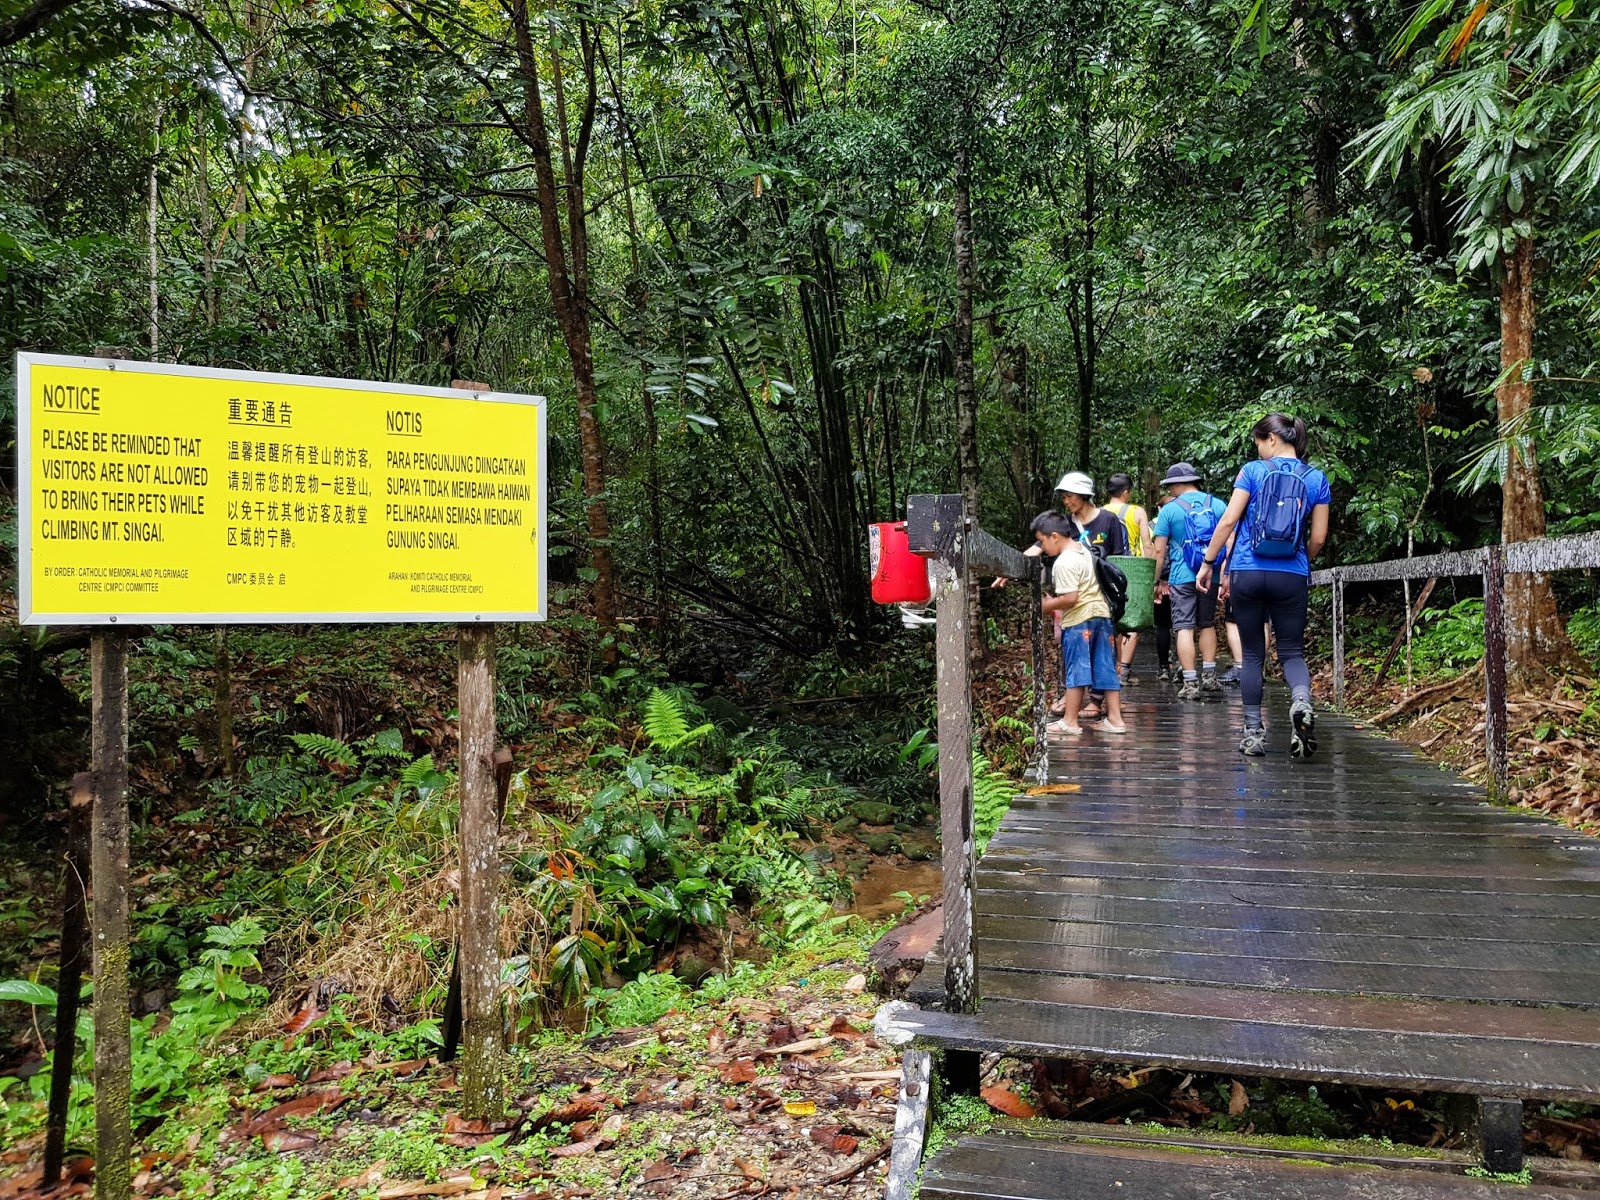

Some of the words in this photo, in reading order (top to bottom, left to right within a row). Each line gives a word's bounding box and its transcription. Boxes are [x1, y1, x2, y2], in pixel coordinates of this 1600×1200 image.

[44, 384, 100, 411] NOTICE
[228, 398, 292, 424] 重要通告
[387, 410, 422, 433] NOTIS
[43, 429, 89, 450] PLEASE
[92, 432, 107, 452] BE
[111, 434, 170, 455] REMINDED
[174, 438, 201, 457] THAT
[43, 459, 95, 481] VISITORS
[101, 463, 123, 482] ARE
[127, 464, 150, 483] NOT
[154, 466, 208, 486] ALLOWED
[387, 451, 411, 469] PARA
[414, 453, 473, 473] PENGUNJUNG
[476, 456, 525, 476] DIINGATKAN
[387, 477, 421, 496] SUPAYA
[424, 479, 449, 497] TIDAK
[452, 481, 495, 499] MEMBAWA
[498, 484, 530, 501] HAIWAN
[42, 489, 57, 509] TO
[62, 491, 97, 511] BRING
[102, 492, 135, 512] THEIR
[138, 494, 166, 514] PETS
[170, 495, 204, 514] WHILE
[228, 500, 367, 524] 以免干扰其他访客及教堂
[386, 504, 443, 523] PELIHARAAN
[446, 507, 482, 525] SEMASA
[484, 508, 521, 526] MENDAKI
[42, 519, 98, 540] CLIMBING
[102, 522, 120, 541] MT.
[124, 523, 165, 542] SINGAI.
[387, 530, 425, 549] GUNUNG
[428, 532, 459, 550] SINGAI.
[45, 567, 52, 576] BY
[79, 568, 107, 577] CATHOLIC
[109, 569, 139, 578] MEMORIAL
[141, 569, 152, 578] AND
[154, 569, 188, 578] PILGRIMAGE
[227, 573, 247, 584] CMPC
[427, 573, 449, 581] CATHOLIC
[450, 573, 472, 581] MEMORIAL
[79, 583, 102, 592] CENTRE
[126, 583, 159, 592] COMMITTEE
[411, 585, 420, 593] AND
[421, 585, 448, 593] PILGRIMAGE
[450, 585, 467, 593] CENTRE
